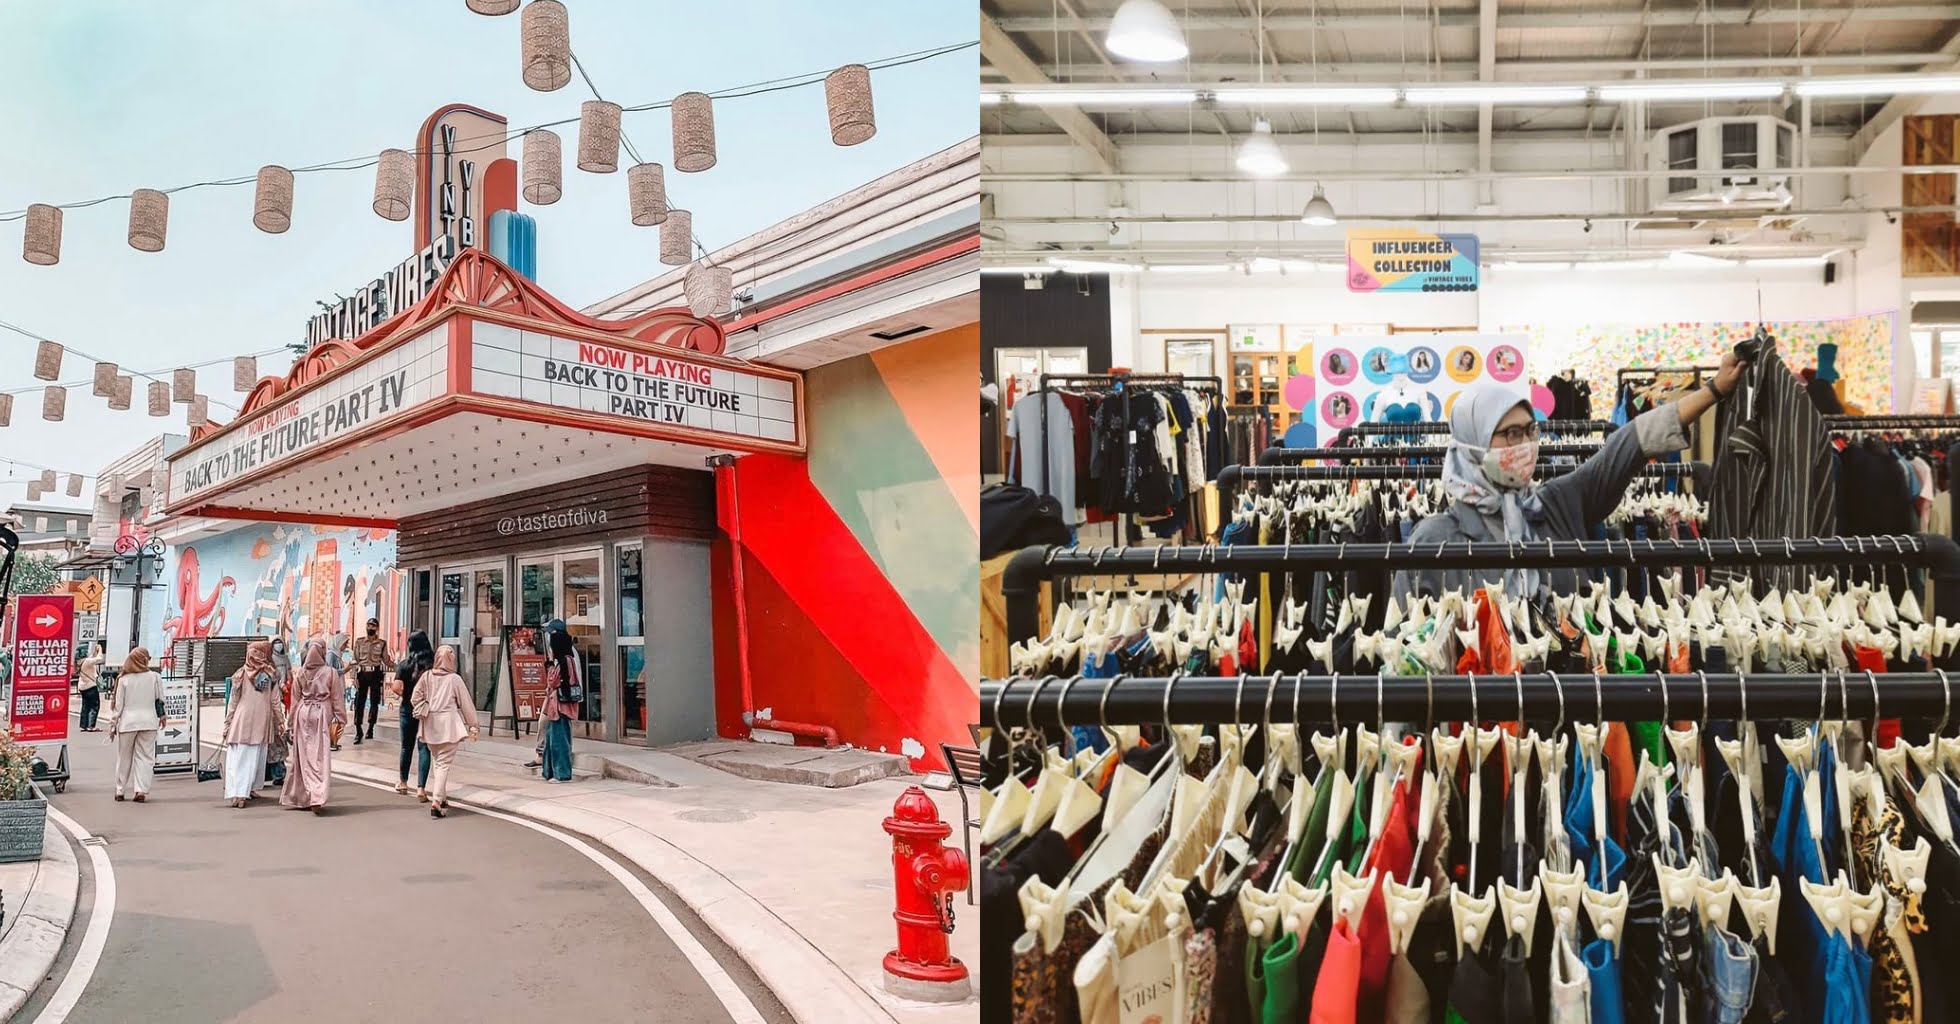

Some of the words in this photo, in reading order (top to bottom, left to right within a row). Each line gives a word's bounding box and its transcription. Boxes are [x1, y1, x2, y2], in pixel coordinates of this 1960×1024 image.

[441, 124, 457, 238] VINT
[459, 160, 475, 248] VIB
[1372, 241, 1453, 254] INFLUENCER
[1373, 260, 1452, 273] COLLECTION
[306, 279, 384, 351] VINTAGE
[384, 234, 454, 320] VIBES
[579, 343, 626, 370] NOW
[632, 354, 712, 385] PLAYING
[544, 360, 598, 388] BACK
[603, 371, 628, 392] TO
[633, 376, 669, 400] THE
[675, 383, 740, 412] FUTURE
[248, 421, 266, 437] NOW
[266, 401, 299, 431] PLAYING
[611, 395, 659, 419] PART
[664, 404, 685, 423] IV
[184, 458, 213, 494] BACK
[215, 456, 230, 481] TO
[233, 440, 257, 474] THE
[260, 414, 320, 463] FUTURE
[324, 384, 374, 437] PART
[379, 370, 407, 414] IV
[20, 639, 69, 649] KELUAR
[82, 629, 95, 639] 20
[19, 648, 68, 657] MELALUI
[19, 656, 68, 666] VINTAGE
[19, 665, 68, 677] VIBES
[166, 708, 187, 716] IBES
